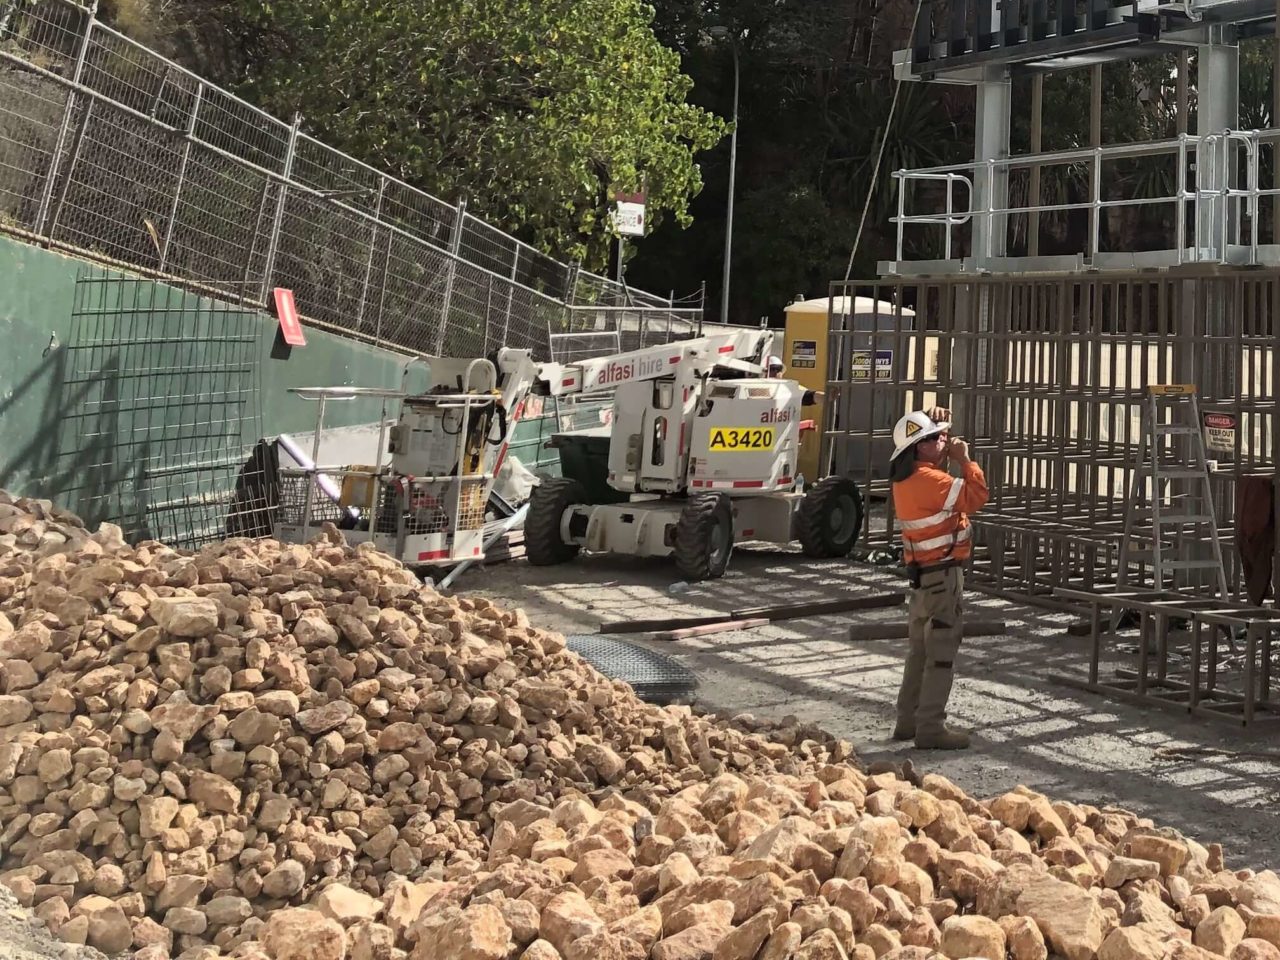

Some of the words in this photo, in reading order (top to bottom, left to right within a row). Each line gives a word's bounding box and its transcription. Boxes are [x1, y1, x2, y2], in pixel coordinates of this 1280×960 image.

[598, 359, 635, 384] alfasi
[638, 356, 663, 377] hire
[760, 407, 791, 423] alfasi
[1208, 416, 1231, 426] DANGER
[710, 430, 773, 448] A3420
[1222, 429, 1234, 438] OUT
